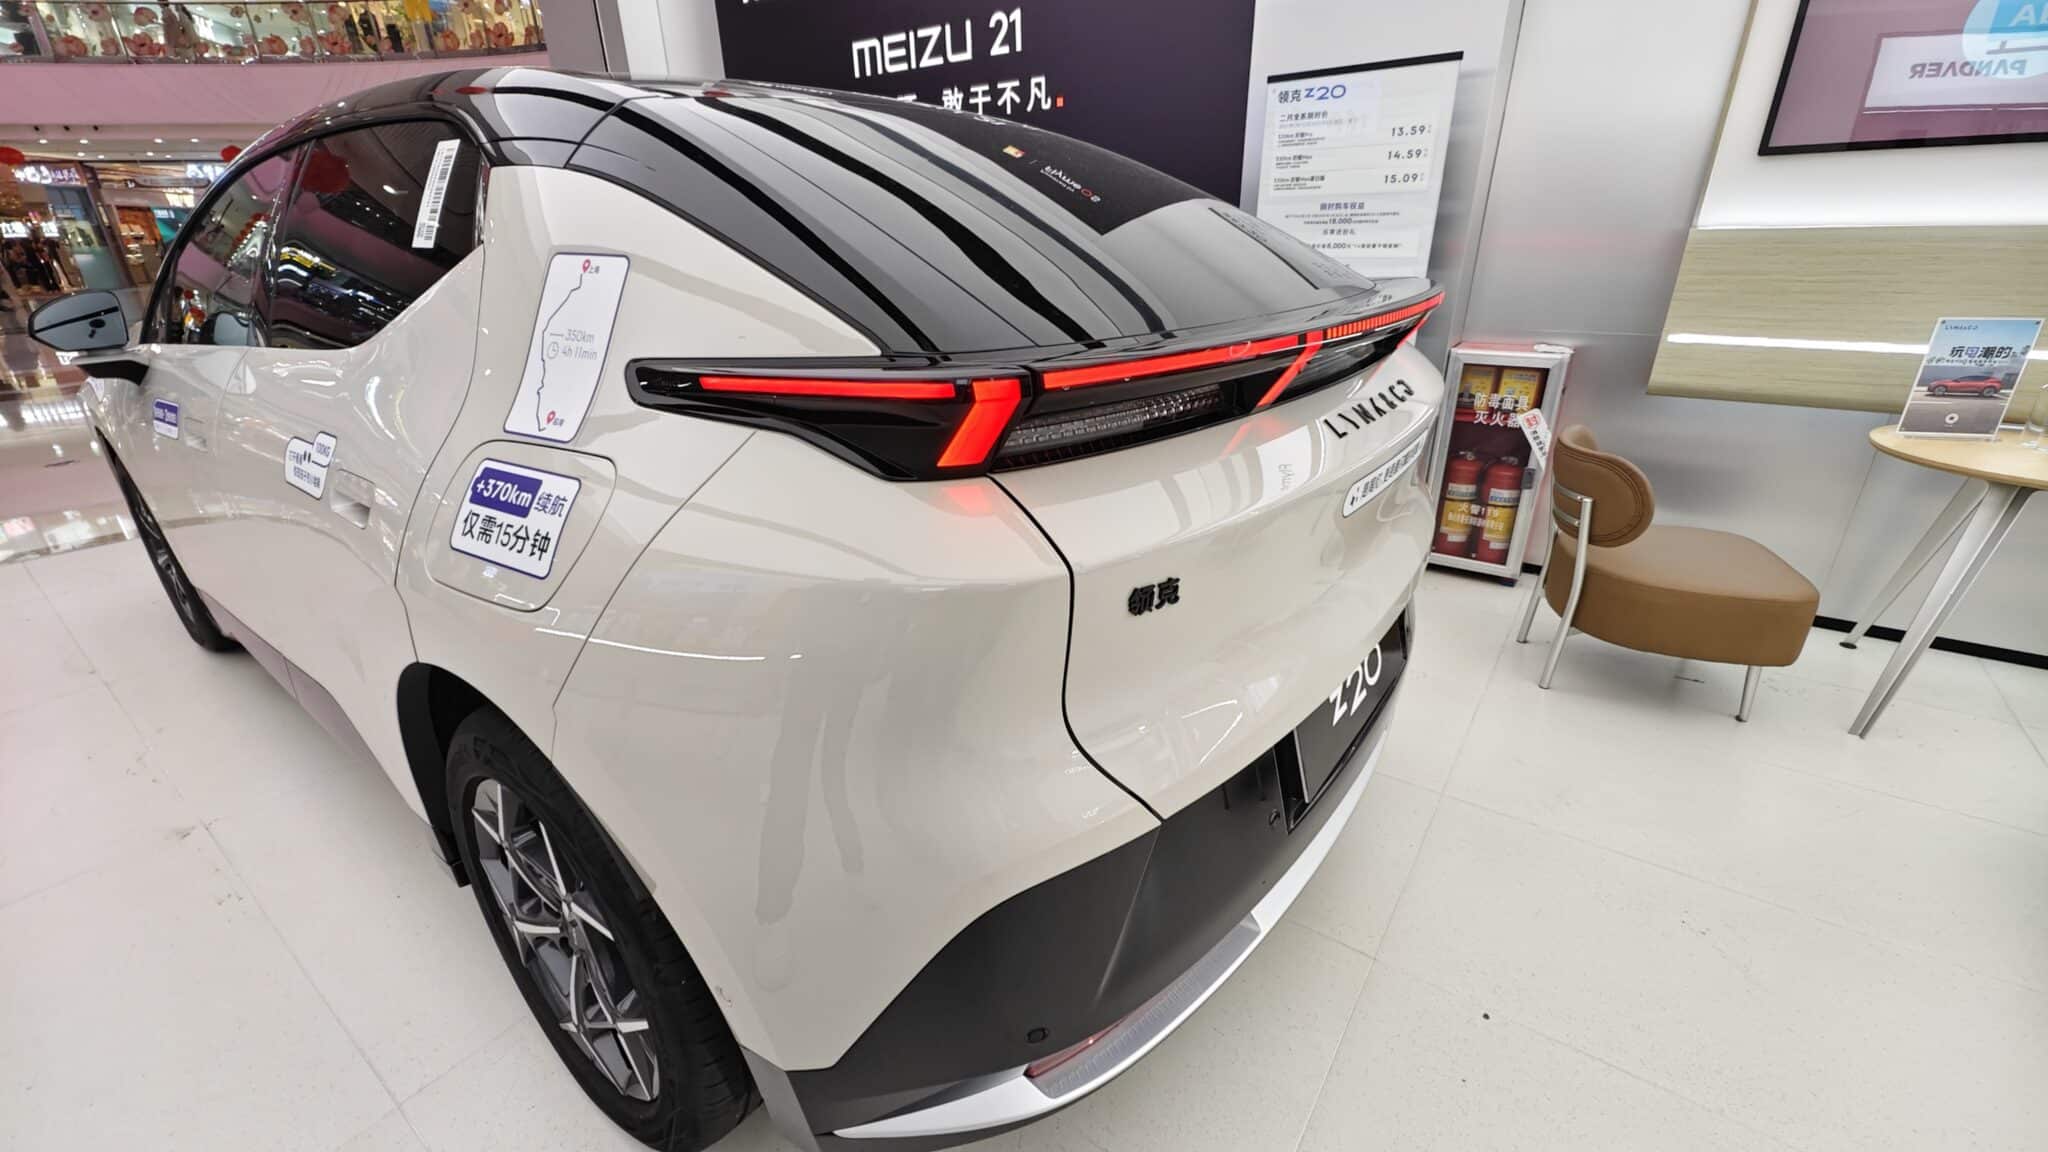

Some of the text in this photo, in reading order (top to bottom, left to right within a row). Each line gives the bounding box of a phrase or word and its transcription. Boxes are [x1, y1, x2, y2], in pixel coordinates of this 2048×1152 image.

[852, 8, 1022, 78] MEIZU 21
[1278, 85, 1347, 104] 领克 Z20
[1391, 124, 1426, 137] 13.59
[1387, 148, 1422, 160] 14.59
[1384, 172, 1418, 184] 15.09
[476, 479, 568, 518] +370km 续航
[461, 509, 551, 561] 仅需15分钟
[1127, 577, 1181, 617] 领克
[1328, 642, 1382, 727] Z20
